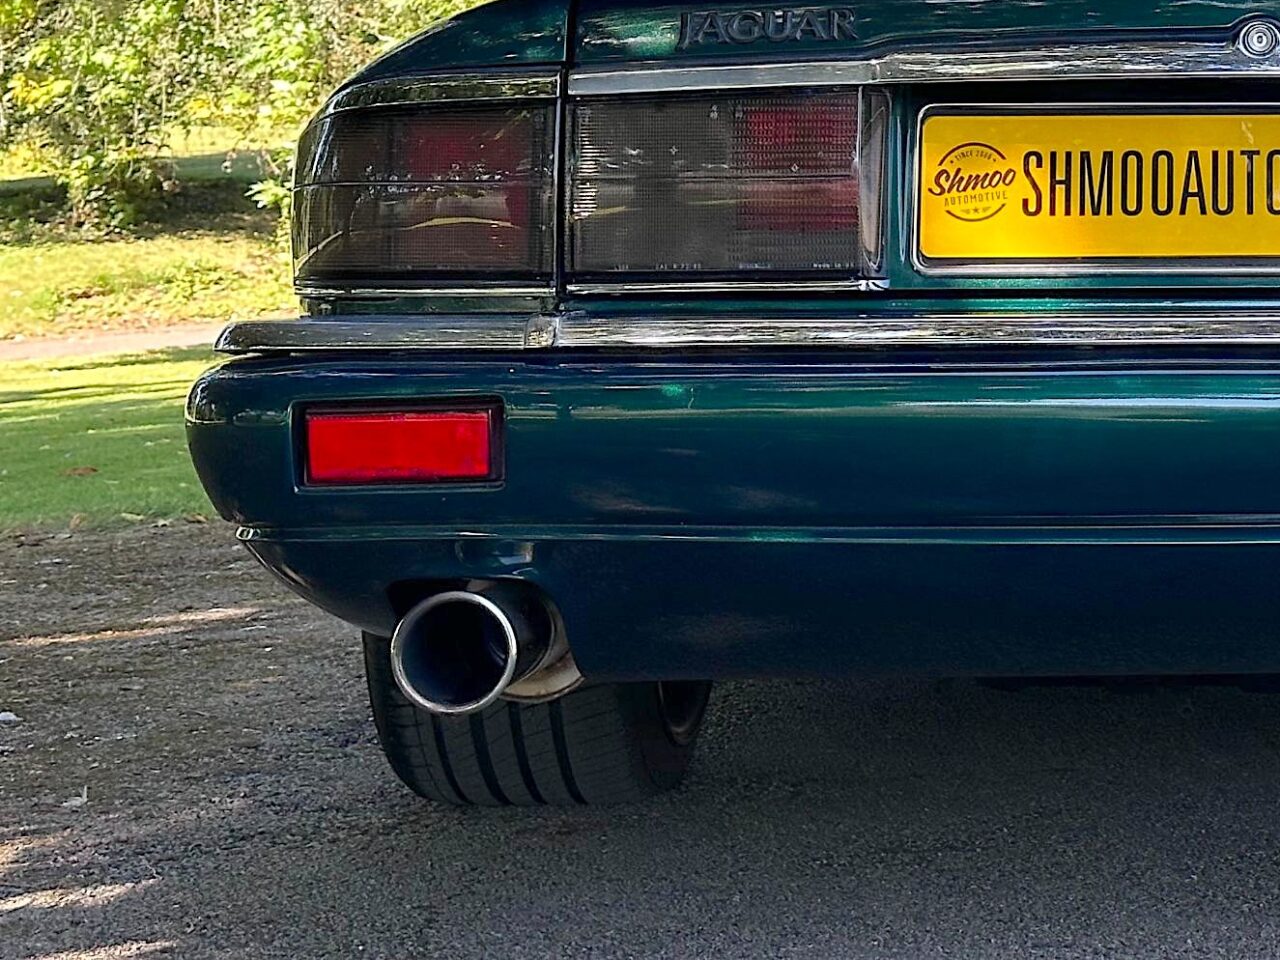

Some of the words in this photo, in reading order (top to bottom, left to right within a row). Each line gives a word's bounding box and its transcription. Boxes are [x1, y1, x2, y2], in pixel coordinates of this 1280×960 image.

[676, 7, 858, 51] JAGUAR
[954, 150, 973, 161] SINCE
[928, 167, 1016, 196] Shmoo
[944, 191, 1008, 207] AUTOMOTIVE
